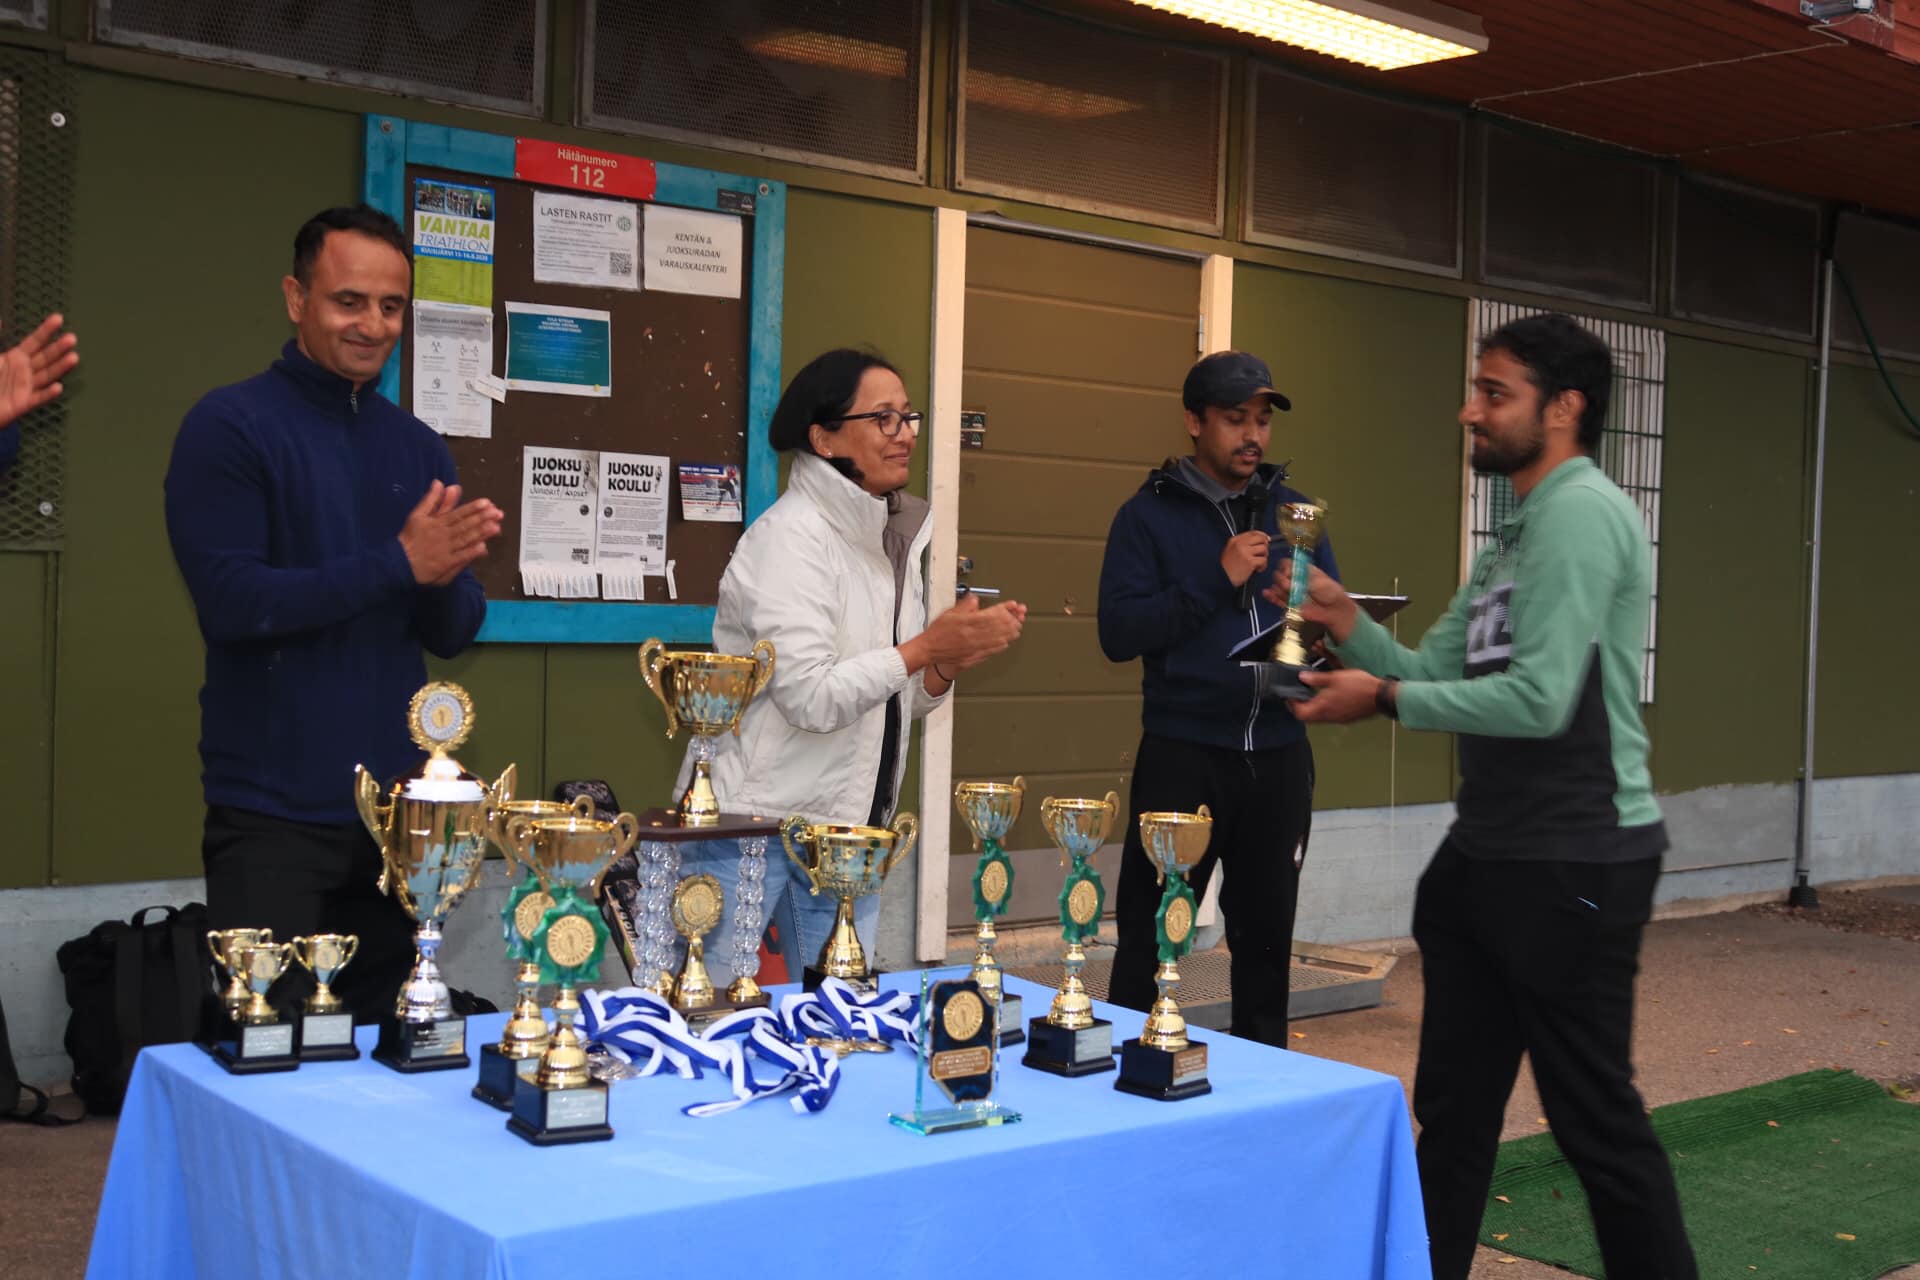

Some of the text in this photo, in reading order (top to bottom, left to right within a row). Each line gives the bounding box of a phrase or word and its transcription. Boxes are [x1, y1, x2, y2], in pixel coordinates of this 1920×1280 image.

[558, 148, 618, 168] Hätänumero
[570, 164, 605, 188] 112
[540, 207, 613, 223] LASTEN RASTIT
[420, 215, 491, 240] VANTAA
[420, 233, 491, 252] TRIATHLON
[674, 231, 705, 244] KENTÄN
[666, 245, 721, 259] JUOKSURADAN
[659, 258, 728, 274] VARAUSKALENTERI
[532, 457, 582, 472] JUOKSU
[608, 462, 654, 477] JUOKSU
[532, 473, 579, 488] KOULU
[608, 478, 651, 493] KOULU
